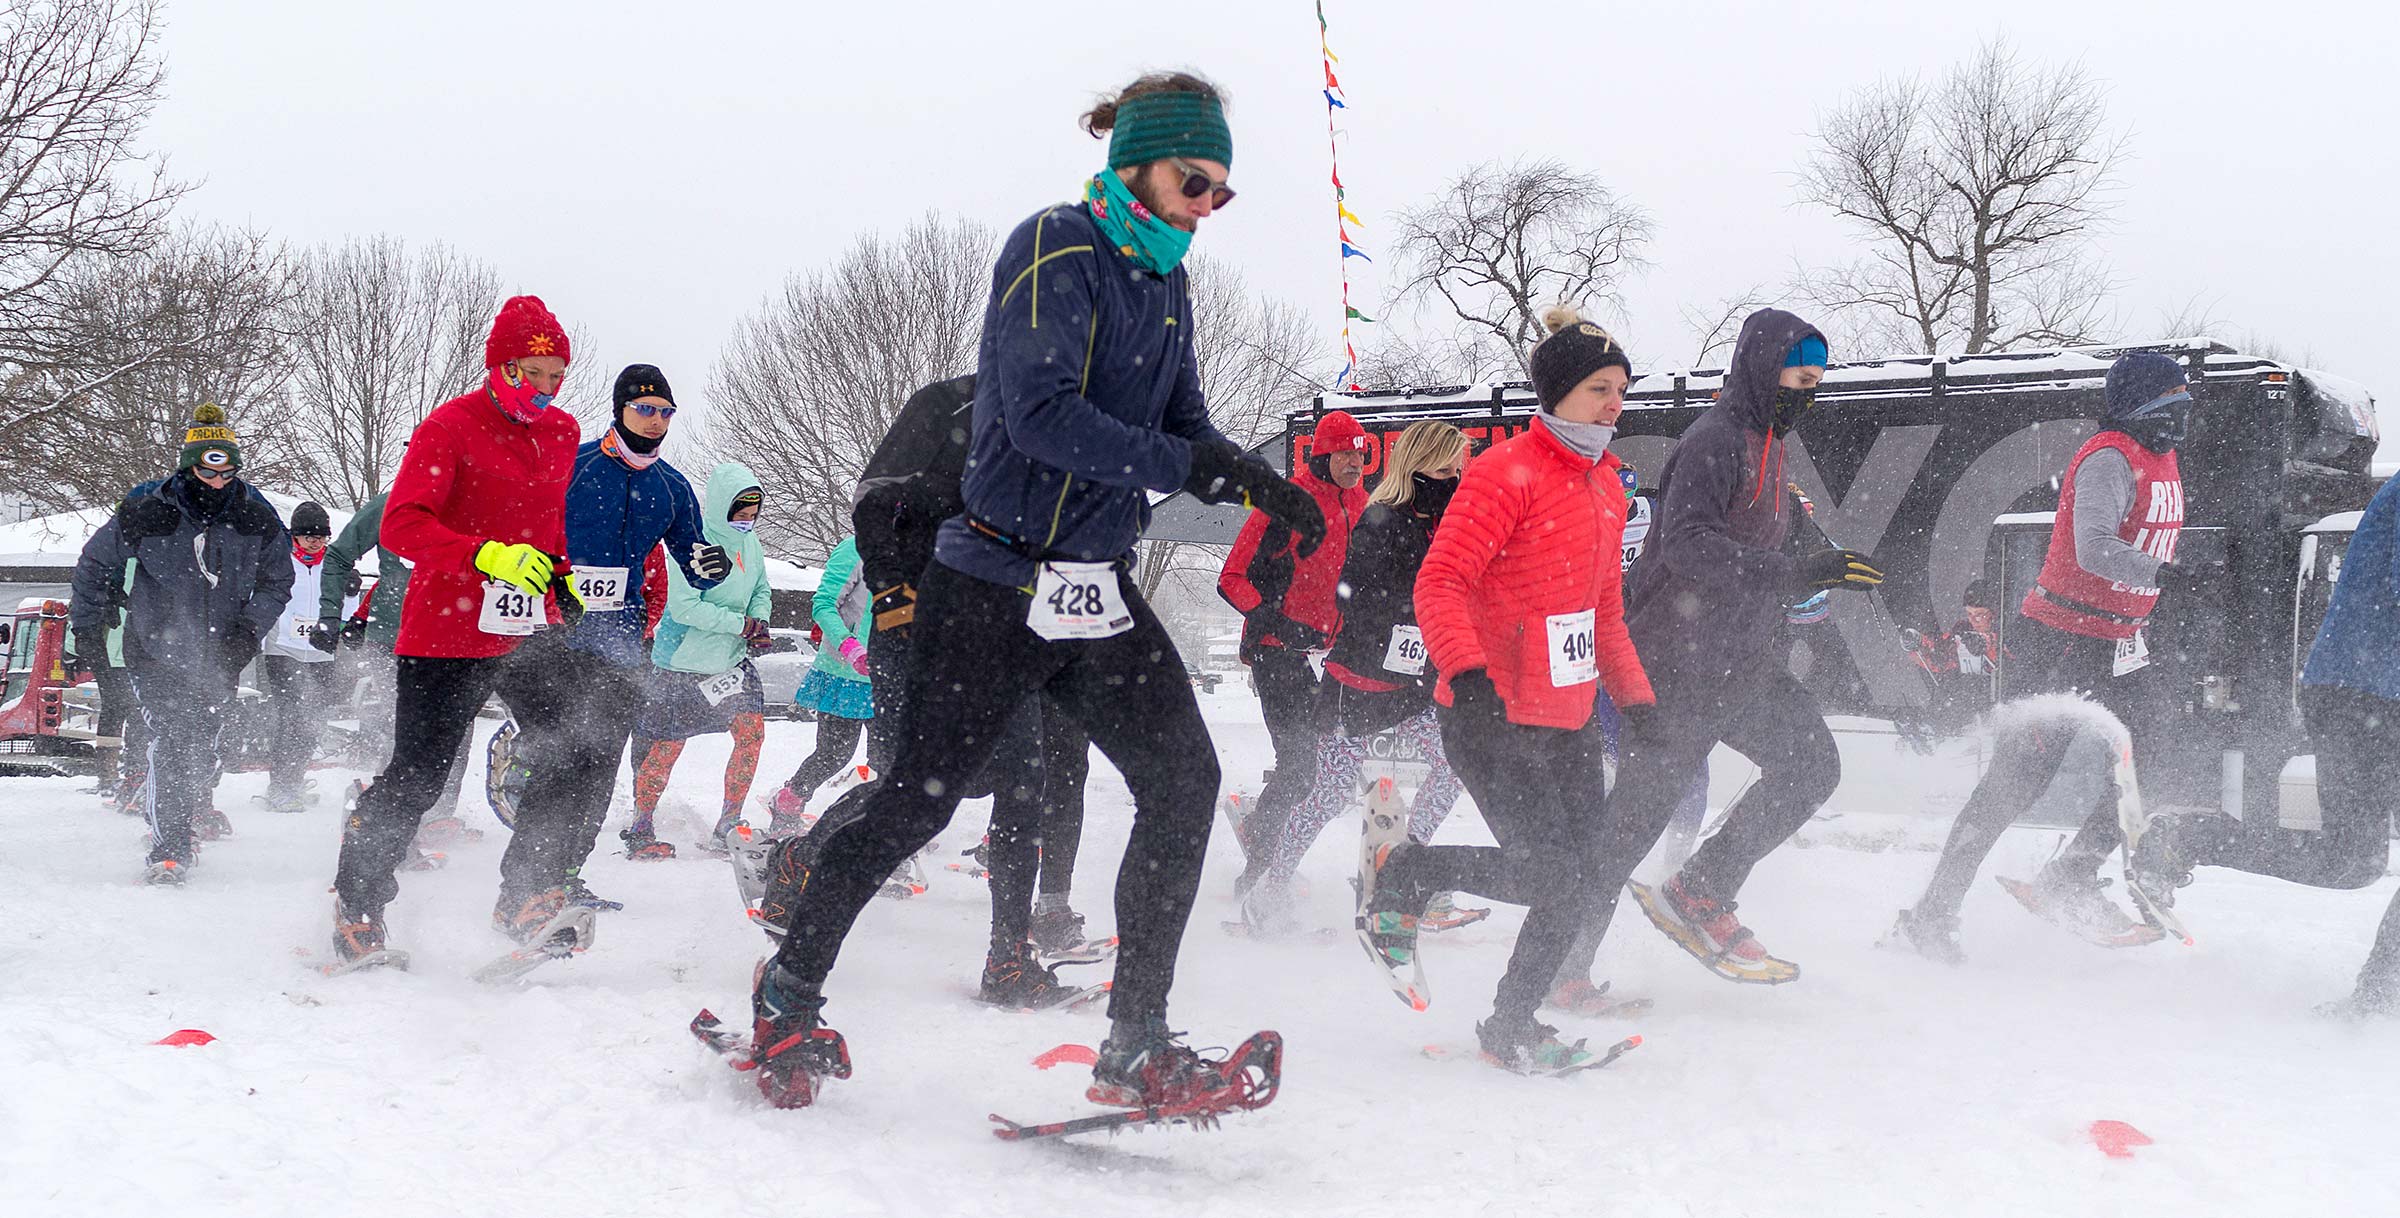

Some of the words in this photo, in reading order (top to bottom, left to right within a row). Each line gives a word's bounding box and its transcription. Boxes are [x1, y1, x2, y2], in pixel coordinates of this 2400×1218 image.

[192, 427, 230, 440] PACKE
[580, 579, 616, 597] 462
[496, 593, 533, 618] 431
[1048, 583, 1104, 616] 428
[1398, 638, 1425, 660] 463
[1563, 629, 1594, 661] 404
[712, 674, 739, 695] 453
